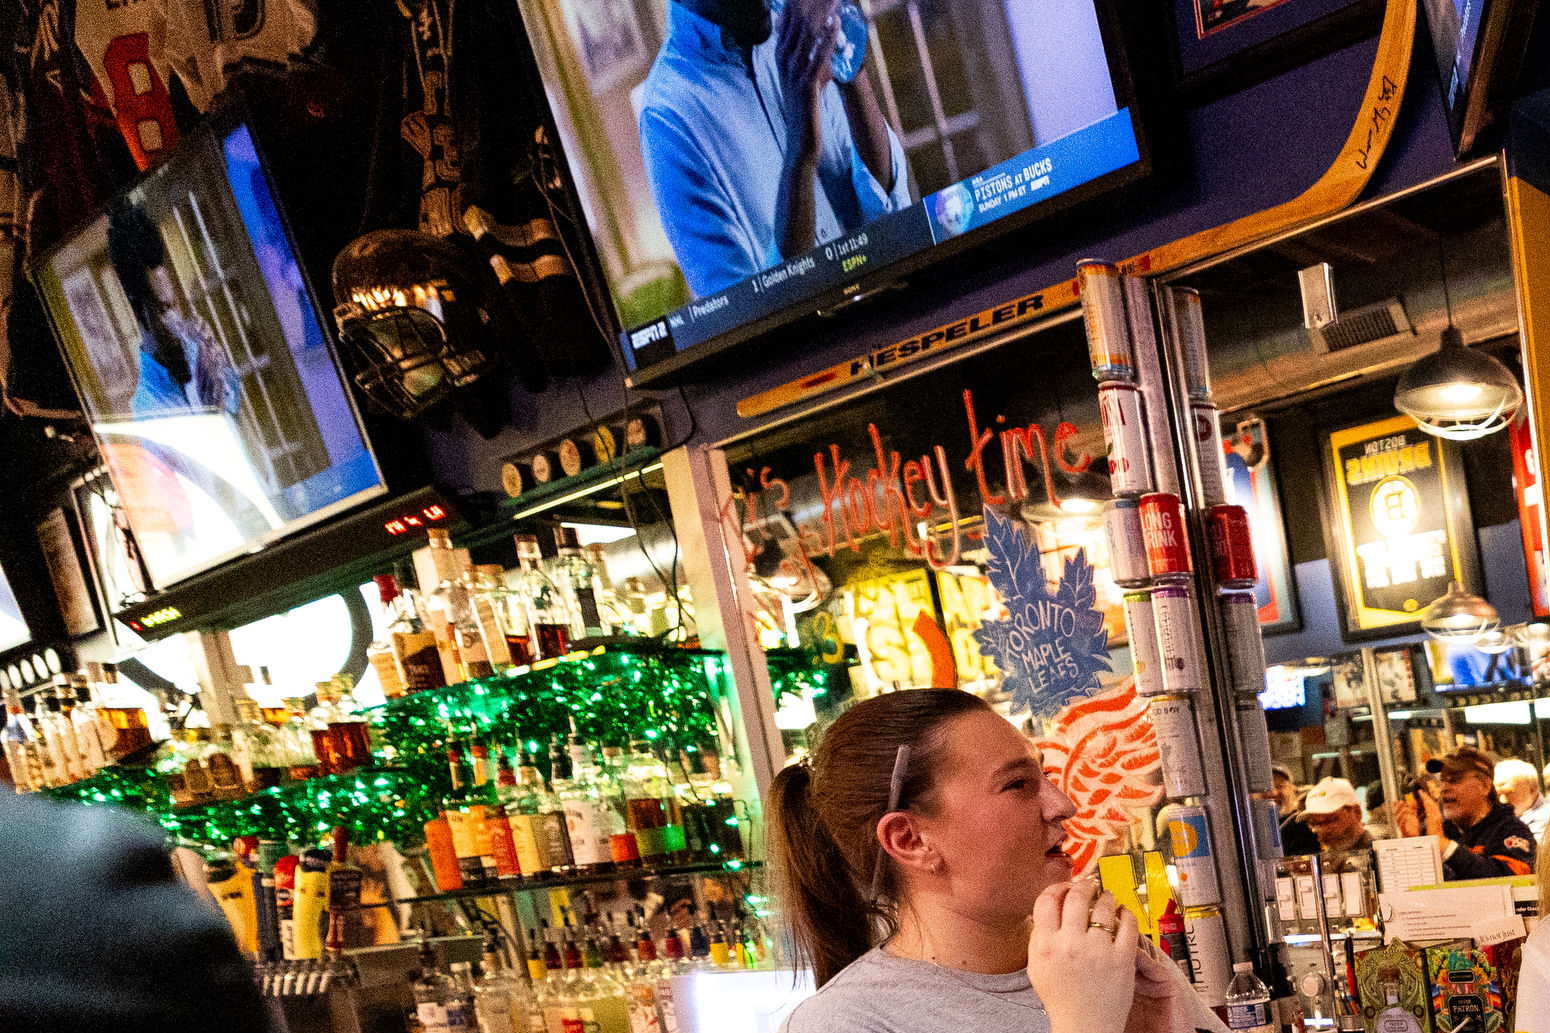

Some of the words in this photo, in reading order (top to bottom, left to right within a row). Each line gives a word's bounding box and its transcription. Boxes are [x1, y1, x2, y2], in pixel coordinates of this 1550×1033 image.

[975, 178, 1013, 201] PISTONS
[1014, 174, 1024, 185] AT
[1022, 158, 1052, 182] BUCKS
[978, 196, 1001, 213] SUNDAY
[763, 264, 788, 285] Golden
[788, 256, 815, 278] Knights
[825, 247, 833, 261] 0
[842, 254, 868, 273] ESPN+
[693, 295, 730, 318] Predators
[850, 295, 1044, 376] HESPELER
[814, 423, 962, 569] Hockey
[962, 389, 1094, 507] time
[1003, 600, 1077, 666] TORONTO
[1021, 635, 1071, 671] MAPLE
[1027, 656, 1079, 693] LEAFS
